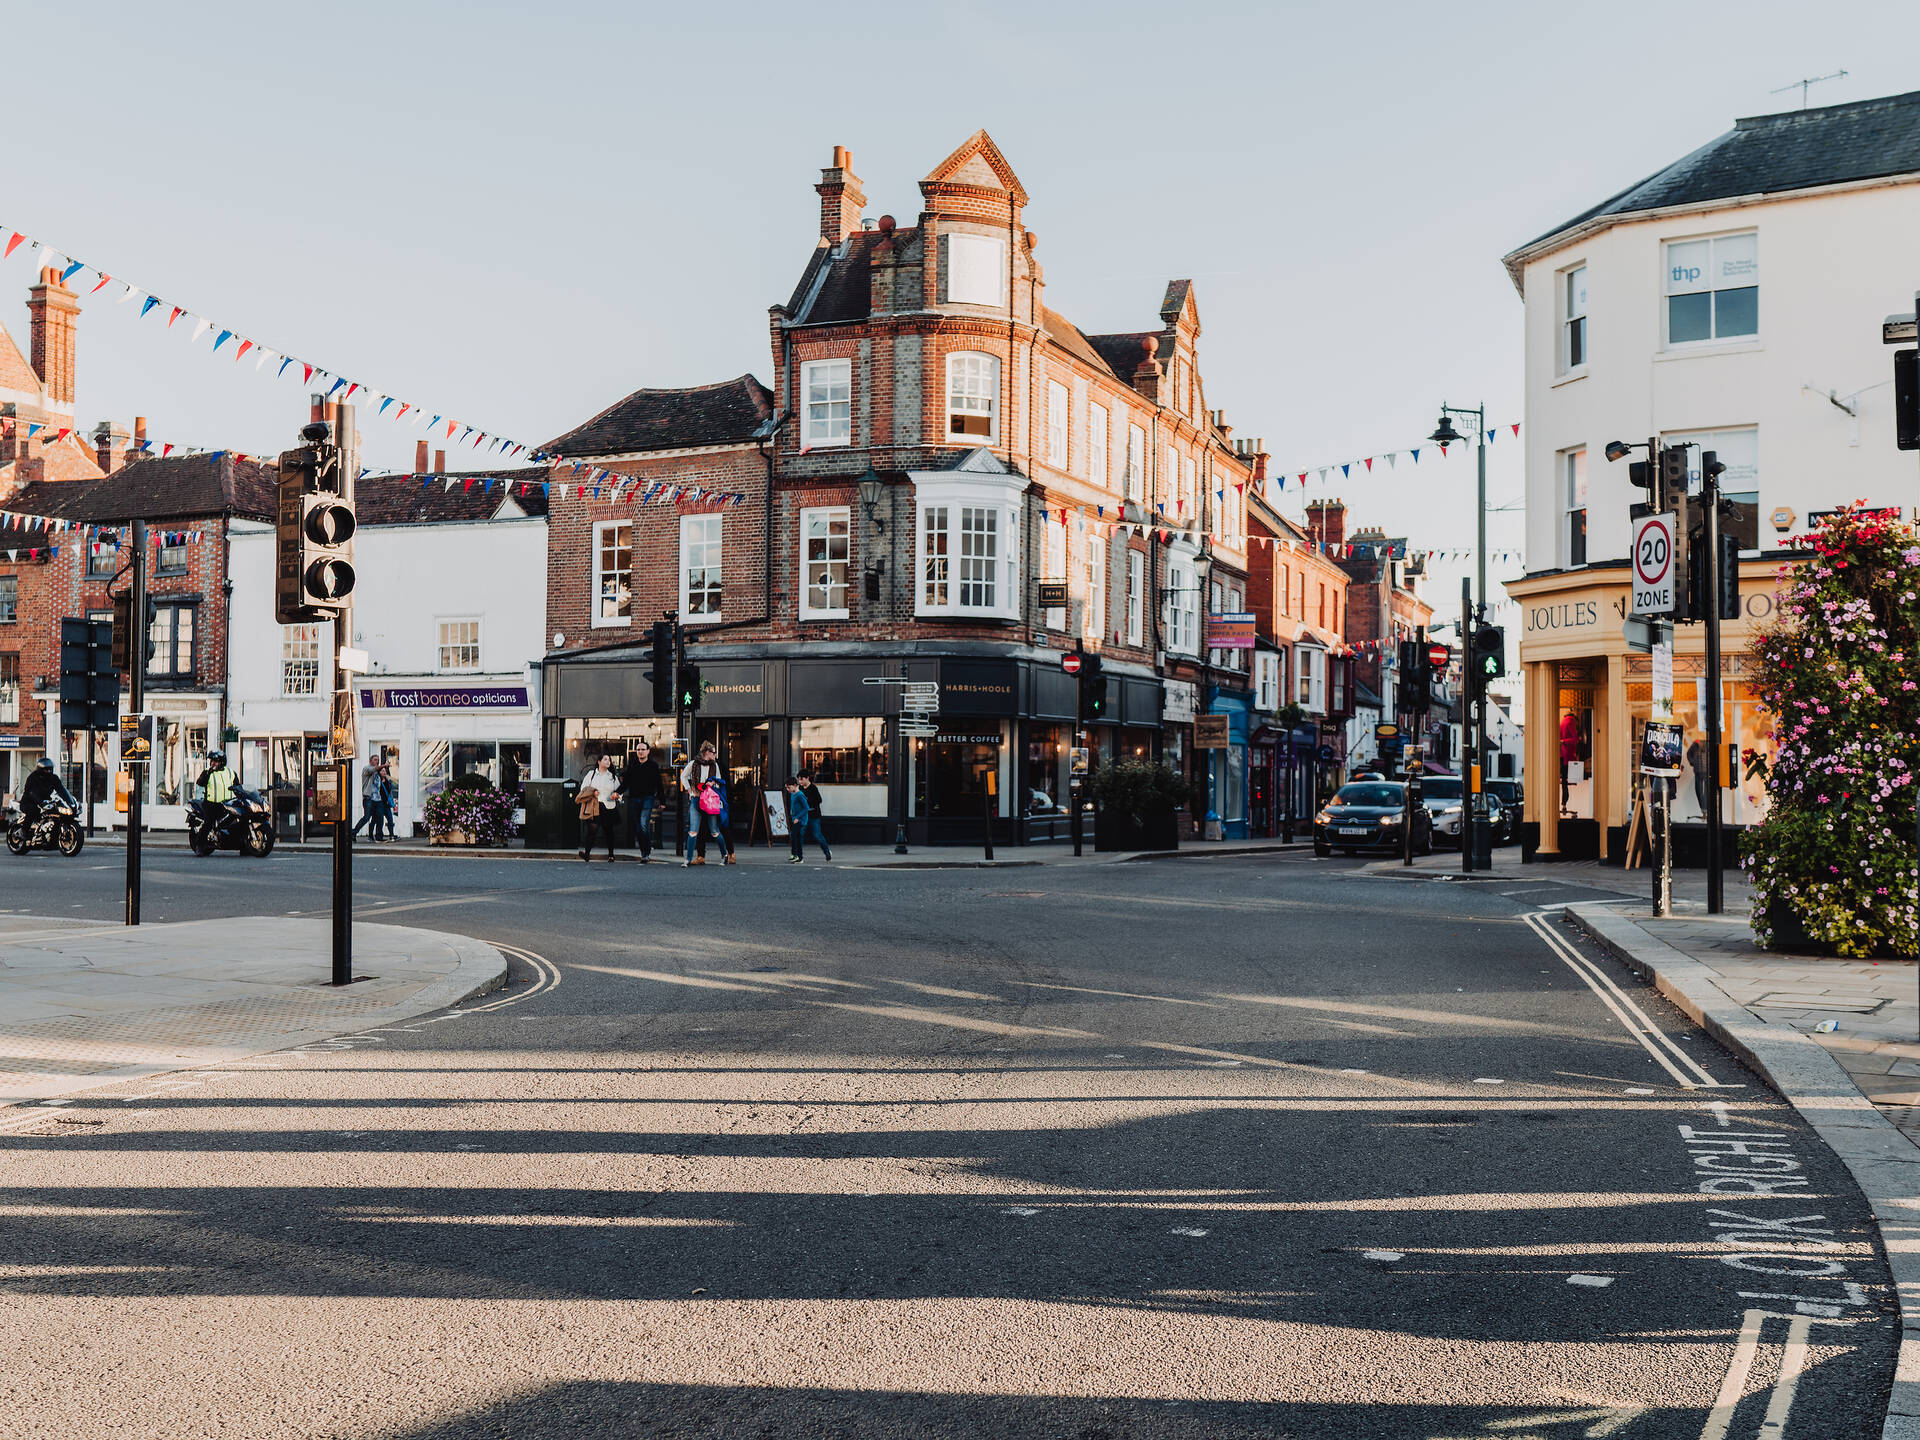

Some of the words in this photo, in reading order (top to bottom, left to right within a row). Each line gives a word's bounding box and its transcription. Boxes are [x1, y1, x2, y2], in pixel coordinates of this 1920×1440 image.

[1672, 265, 1701, 283] thp
[1642, 538, 1667, 566] 20
[1637, 589, 1669, 607] ZONE
[1527, 601, 1597, 632] JOULES
[705, 684, 761, 693] ARRIS+HOOLE
[946, 684, 1011, 693] HARRIS+HOOLE
[472, 693, 517, 704] opticians
[971, 735, 1000, 743] COFFEE
[1678, 1124, 1809, 1195] RIGHT
[1706, 1208, 1870, 1306] LOOK
